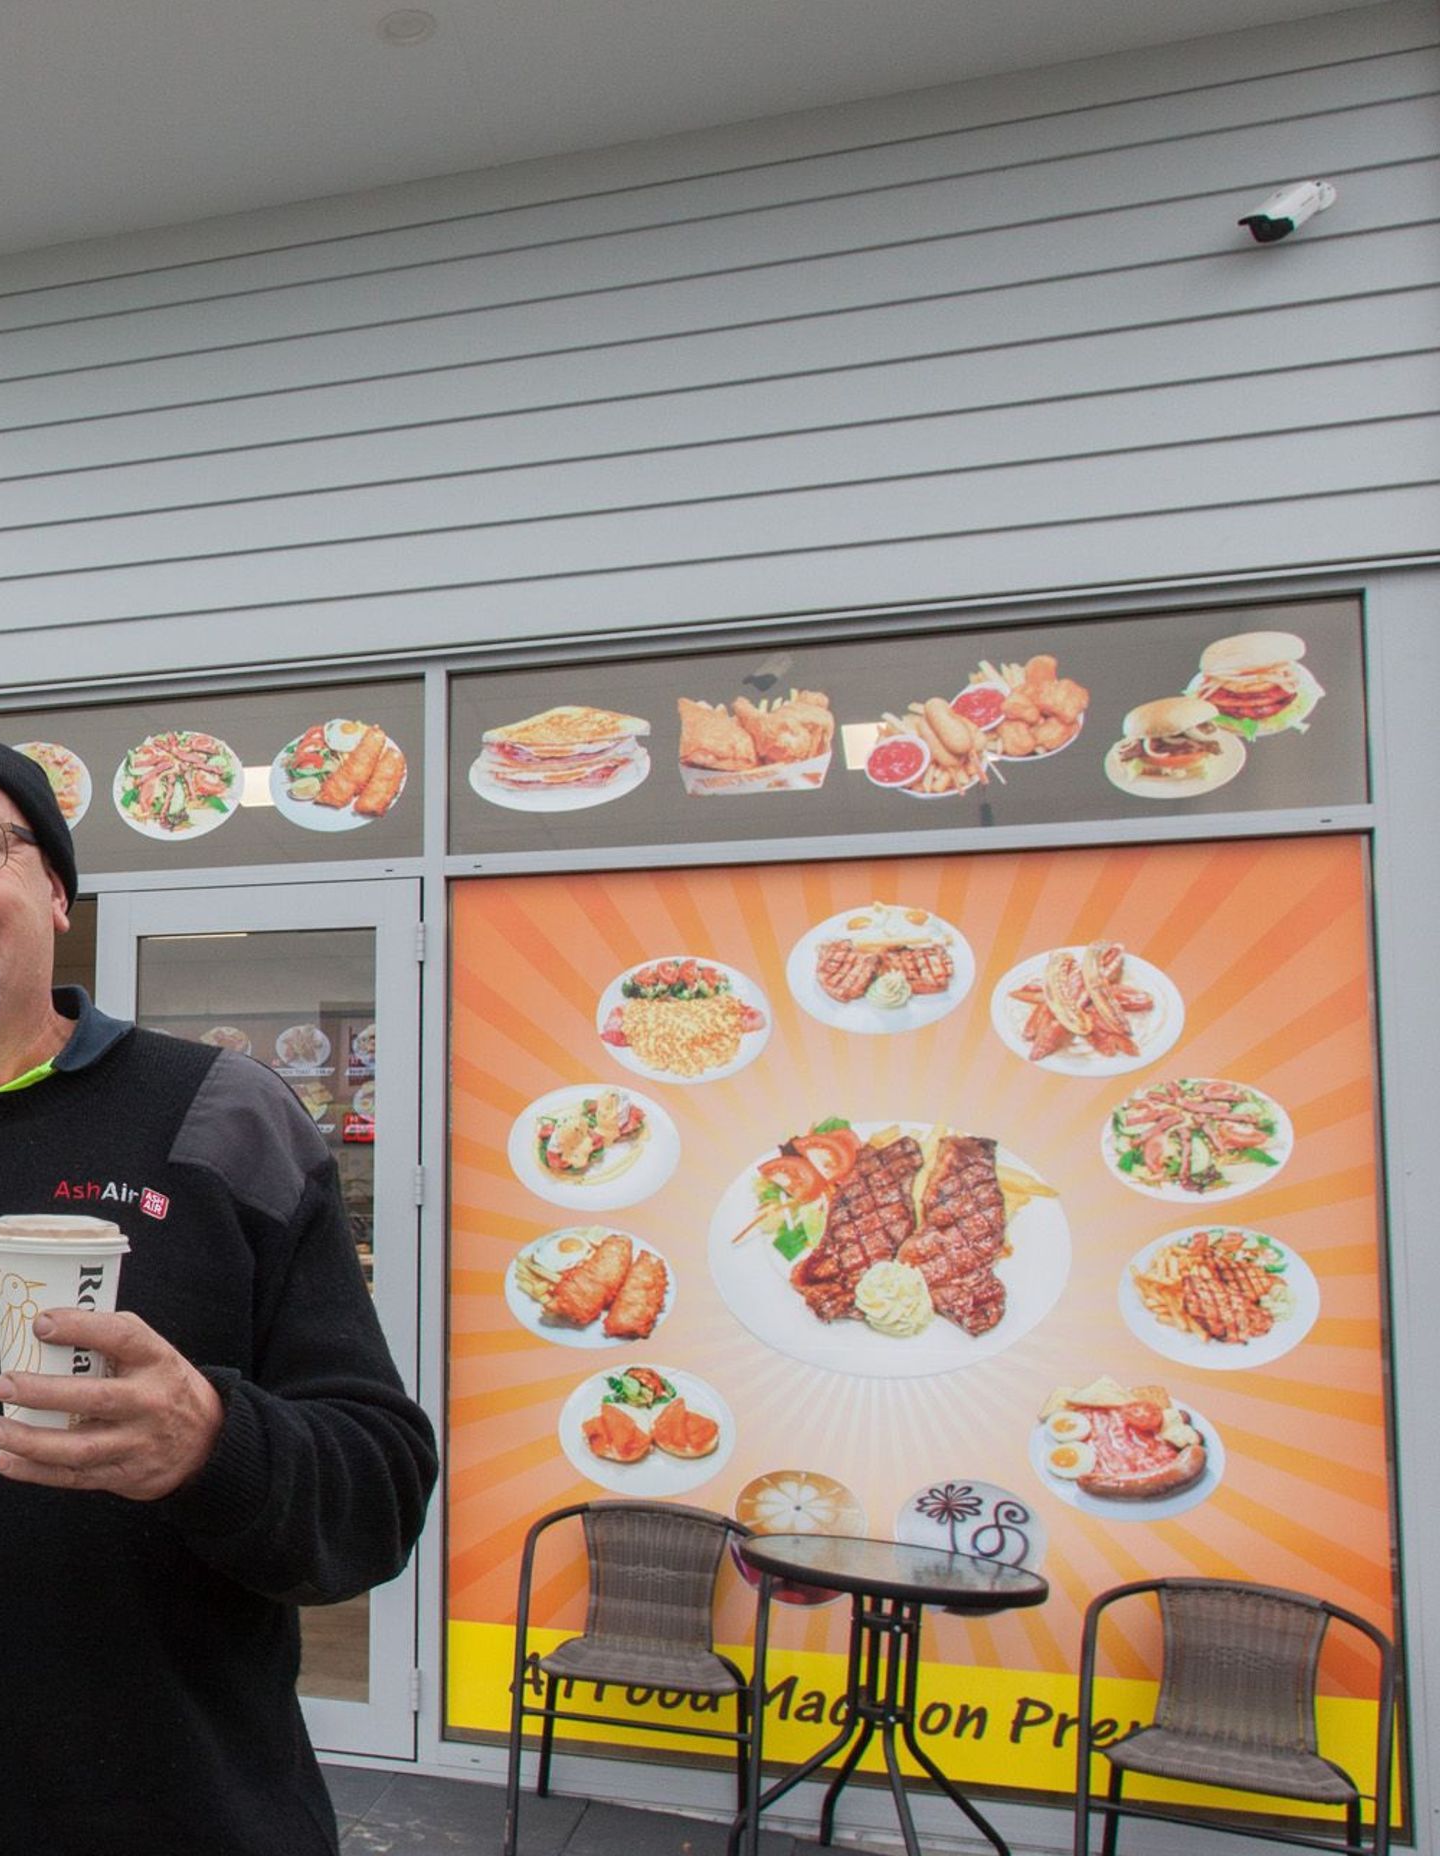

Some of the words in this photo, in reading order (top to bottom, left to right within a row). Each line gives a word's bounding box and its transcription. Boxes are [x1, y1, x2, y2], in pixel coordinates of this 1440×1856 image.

[54, 1180, 139, 1203] AshAir
[72, 1264, 104, 1374] Roa
[747, 1675, 898, 1730] Mad
[919, 1701, 988, 1740] on
